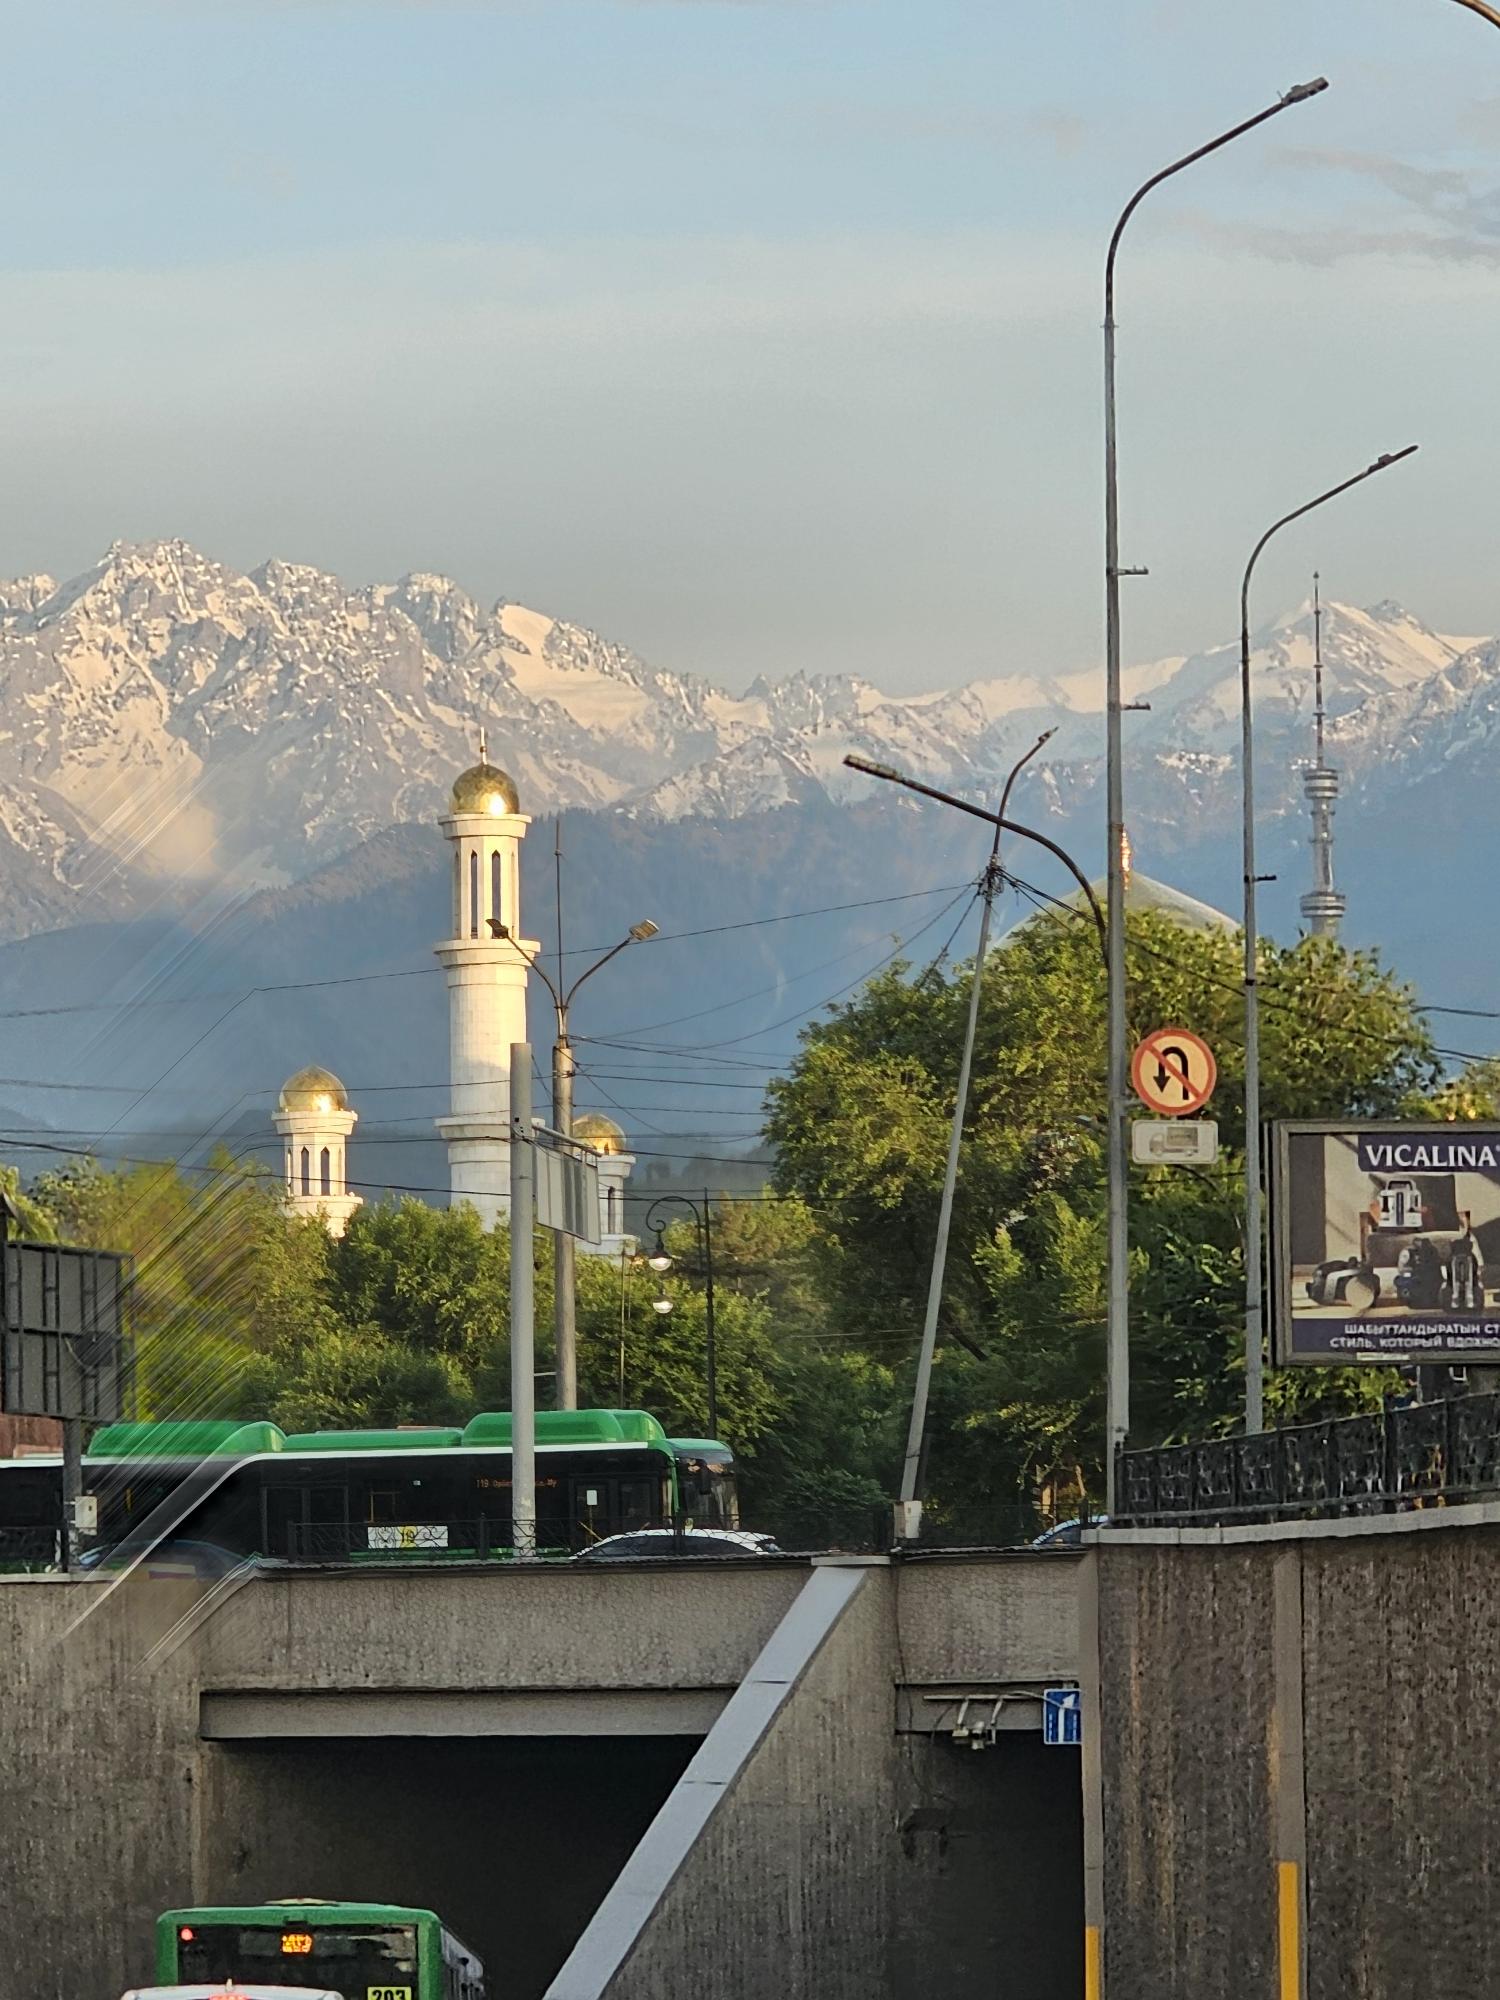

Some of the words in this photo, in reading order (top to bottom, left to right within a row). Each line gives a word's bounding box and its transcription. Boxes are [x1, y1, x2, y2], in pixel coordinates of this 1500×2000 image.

[1365, 1144, 1497, 1167] VICALINA
[1344, 1324, 1480, 1335] ШАБЫТТАНДЫРАТЫН
[1380, 1335, 1442, 1348] КОТОРЫЙ
